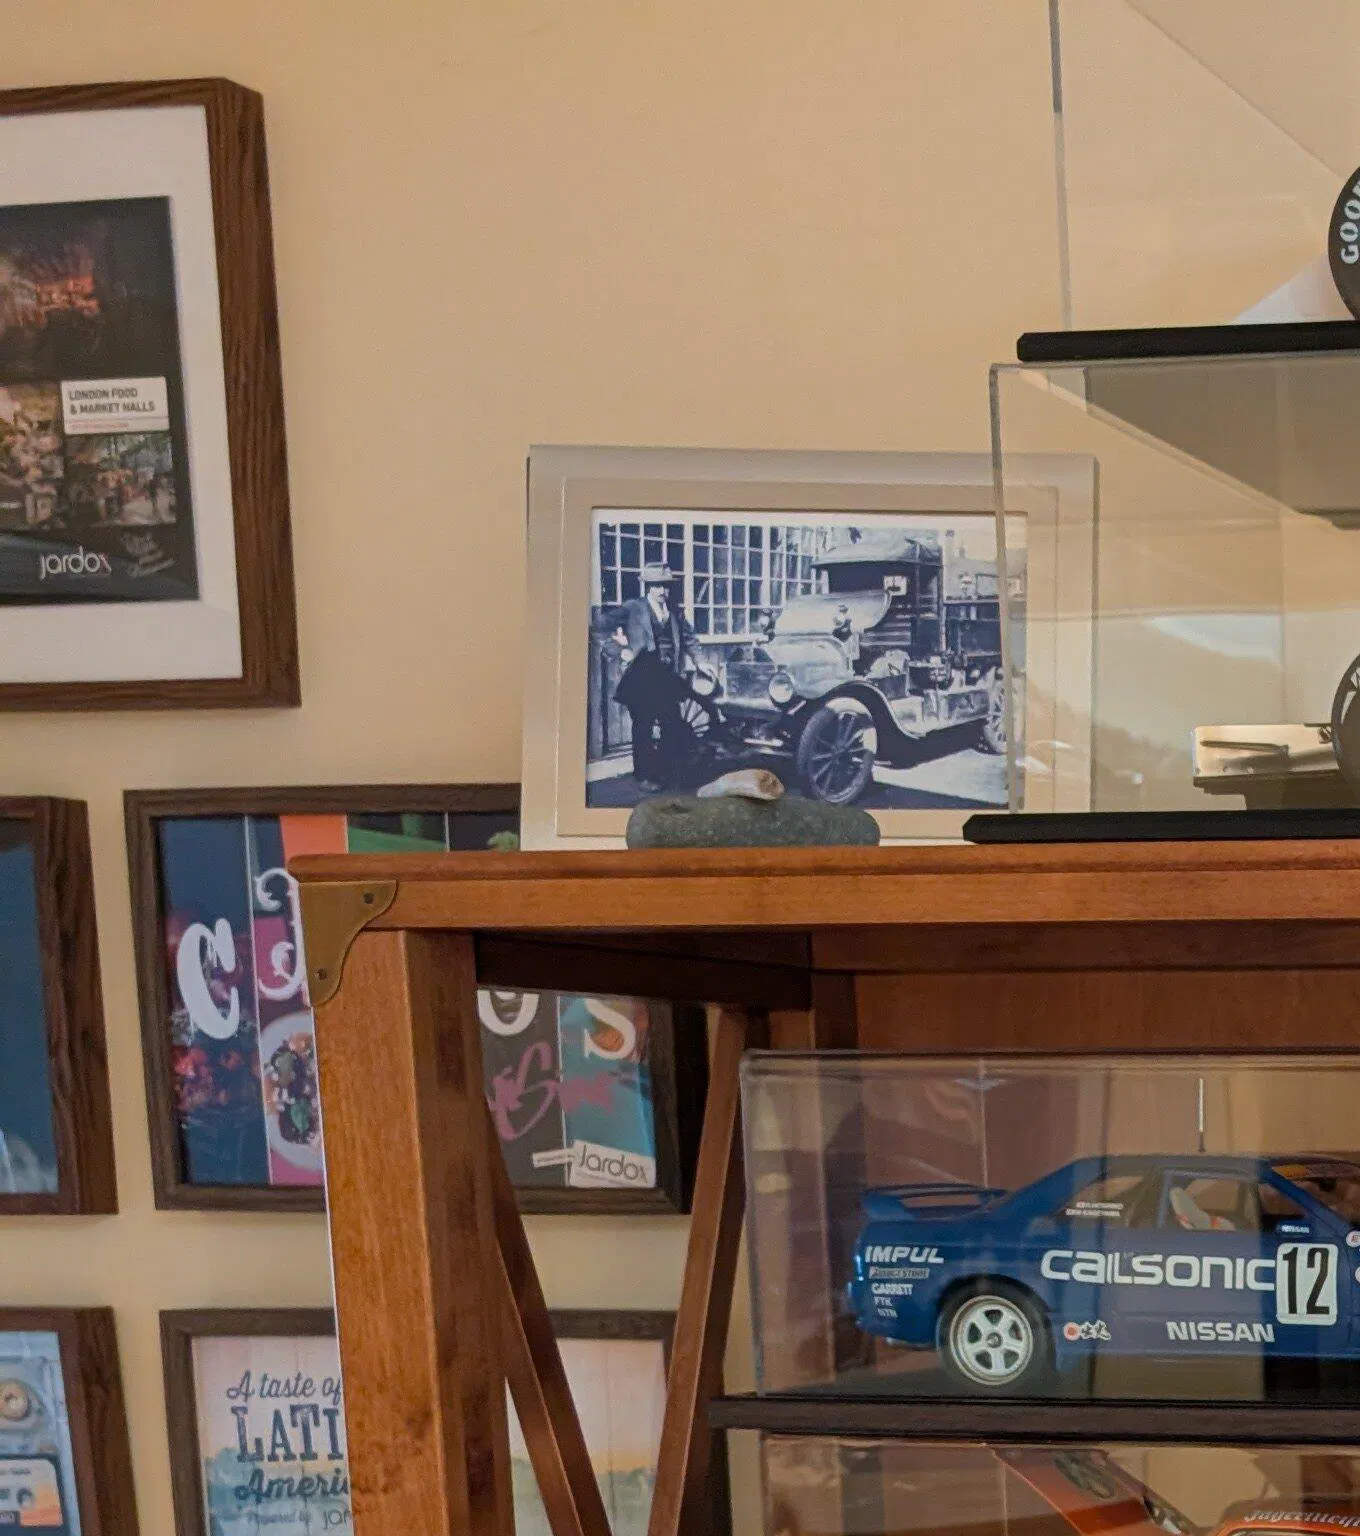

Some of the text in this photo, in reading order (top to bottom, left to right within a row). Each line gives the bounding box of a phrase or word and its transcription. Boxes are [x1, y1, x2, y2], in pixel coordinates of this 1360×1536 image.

[69, 387, 138, 400] LONDON FOOD
[80, 404, 120, 414] MARKET
[122, 401, 155, 412] HALLS
[865, 1246, 944, 1264] IMPUL
[1283, 1247, 1329, 1315] 12
[1167, 1321, 1275, 1344] NISSAN
[227, 1369, 255, 1403] A
[260, 1372, 316, 1399] taste
[234, 1468, 349, 1504] Ameri
